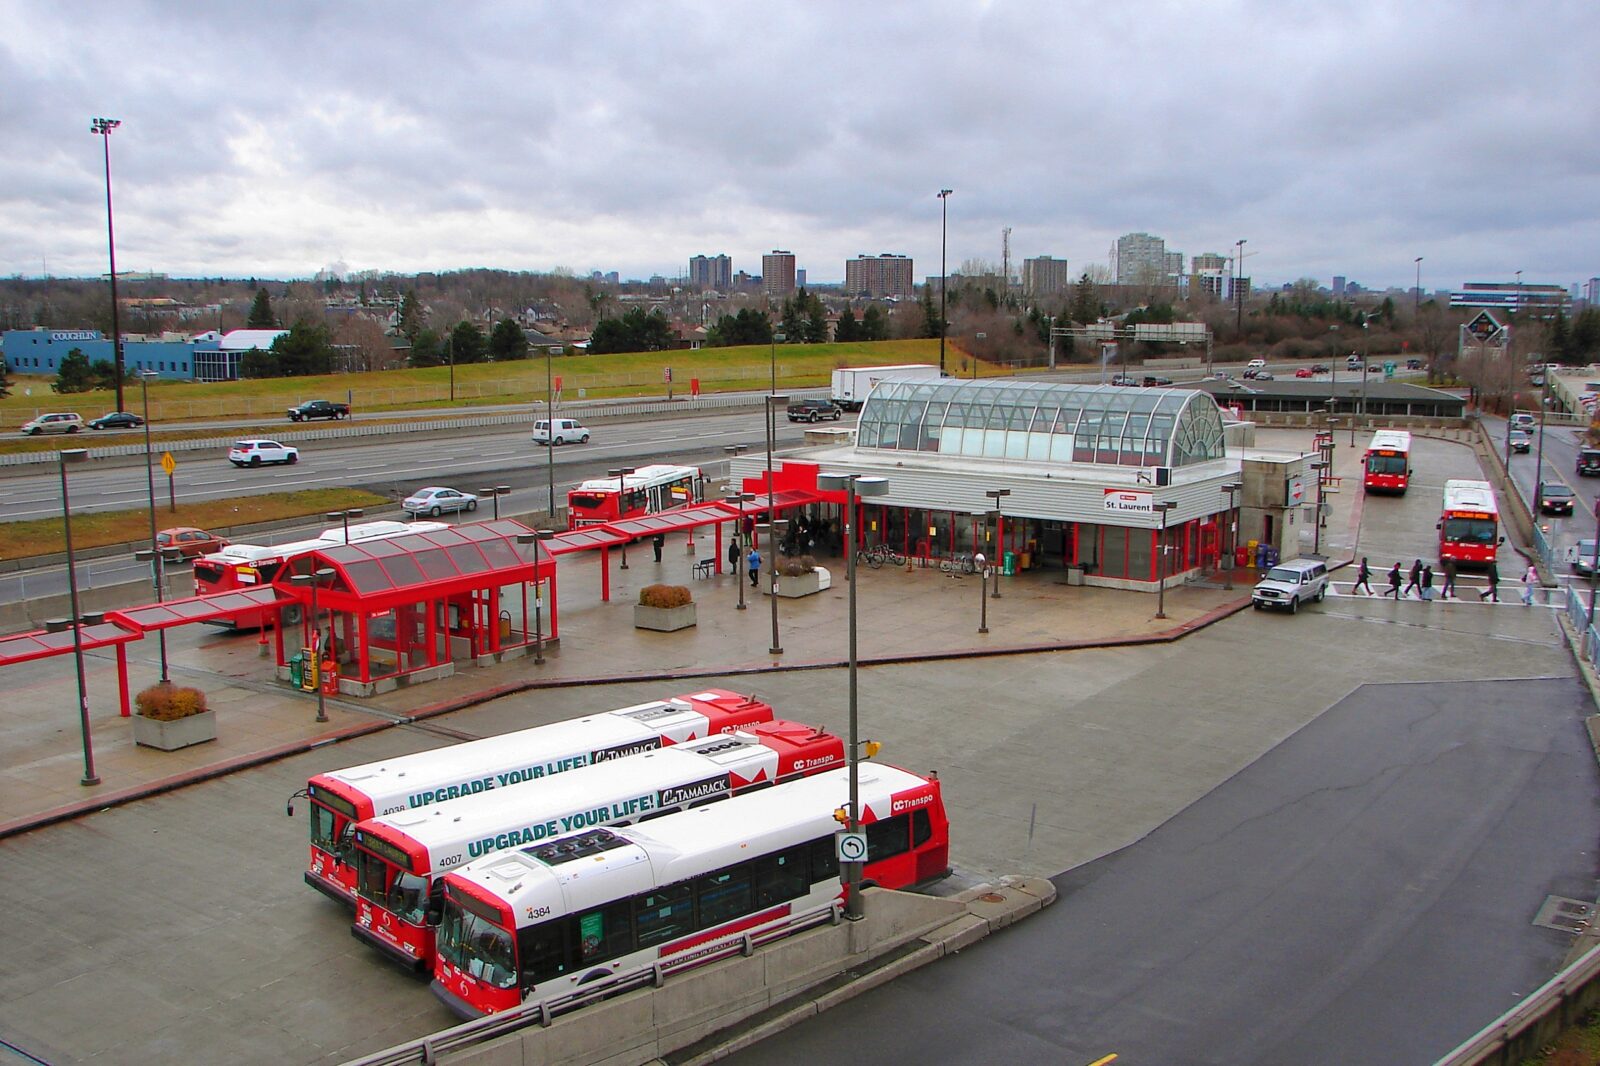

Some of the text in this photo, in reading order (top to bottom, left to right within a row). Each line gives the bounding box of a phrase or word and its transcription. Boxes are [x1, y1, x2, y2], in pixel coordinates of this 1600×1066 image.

[52, 332, 97, 340] COUGHLIN
[1106, 501, 1151, 511] St. Laurent
[607, 742, 656, 760] TAMARACK
[806, 754, 834, 768] Transpo
[409, 777, 495, 809] UPGRADE
[497, 765, 544, 787] YOUR
[547, 755, 587, 775] LIFE!
[676, 779, 726, 801] TAMARACK
[904, 794, 934, 809] Transpo
[468, 820, 559, 858] UPGRADE
[561, 807, 610, 831] YOUR
[613, 794, 654, 818] LIFE!
[439, 854, 462, 867] 4007
[527, 906, 551, 920] 4384
